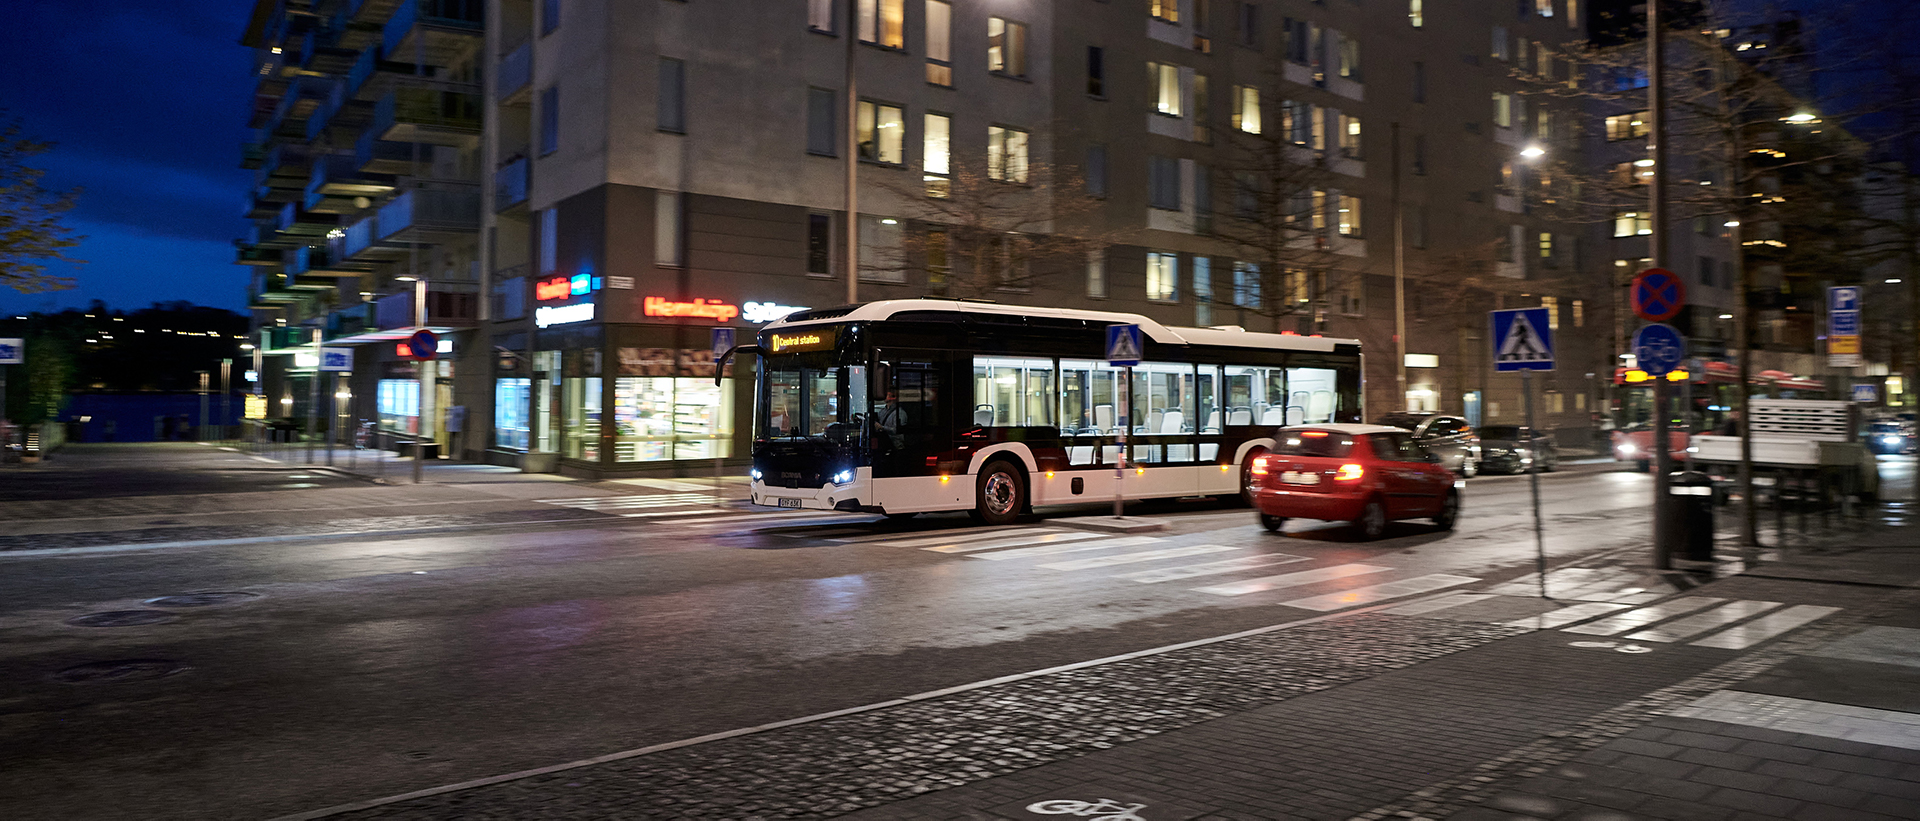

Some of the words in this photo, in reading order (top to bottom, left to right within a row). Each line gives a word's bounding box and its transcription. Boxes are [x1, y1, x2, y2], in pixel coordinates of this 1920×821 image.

[1837, 289, 1856, 309] P
[772, 334, 780, 351] 10
[780, 336, 799, 346] Central
[800, 335, 820, 345] station
